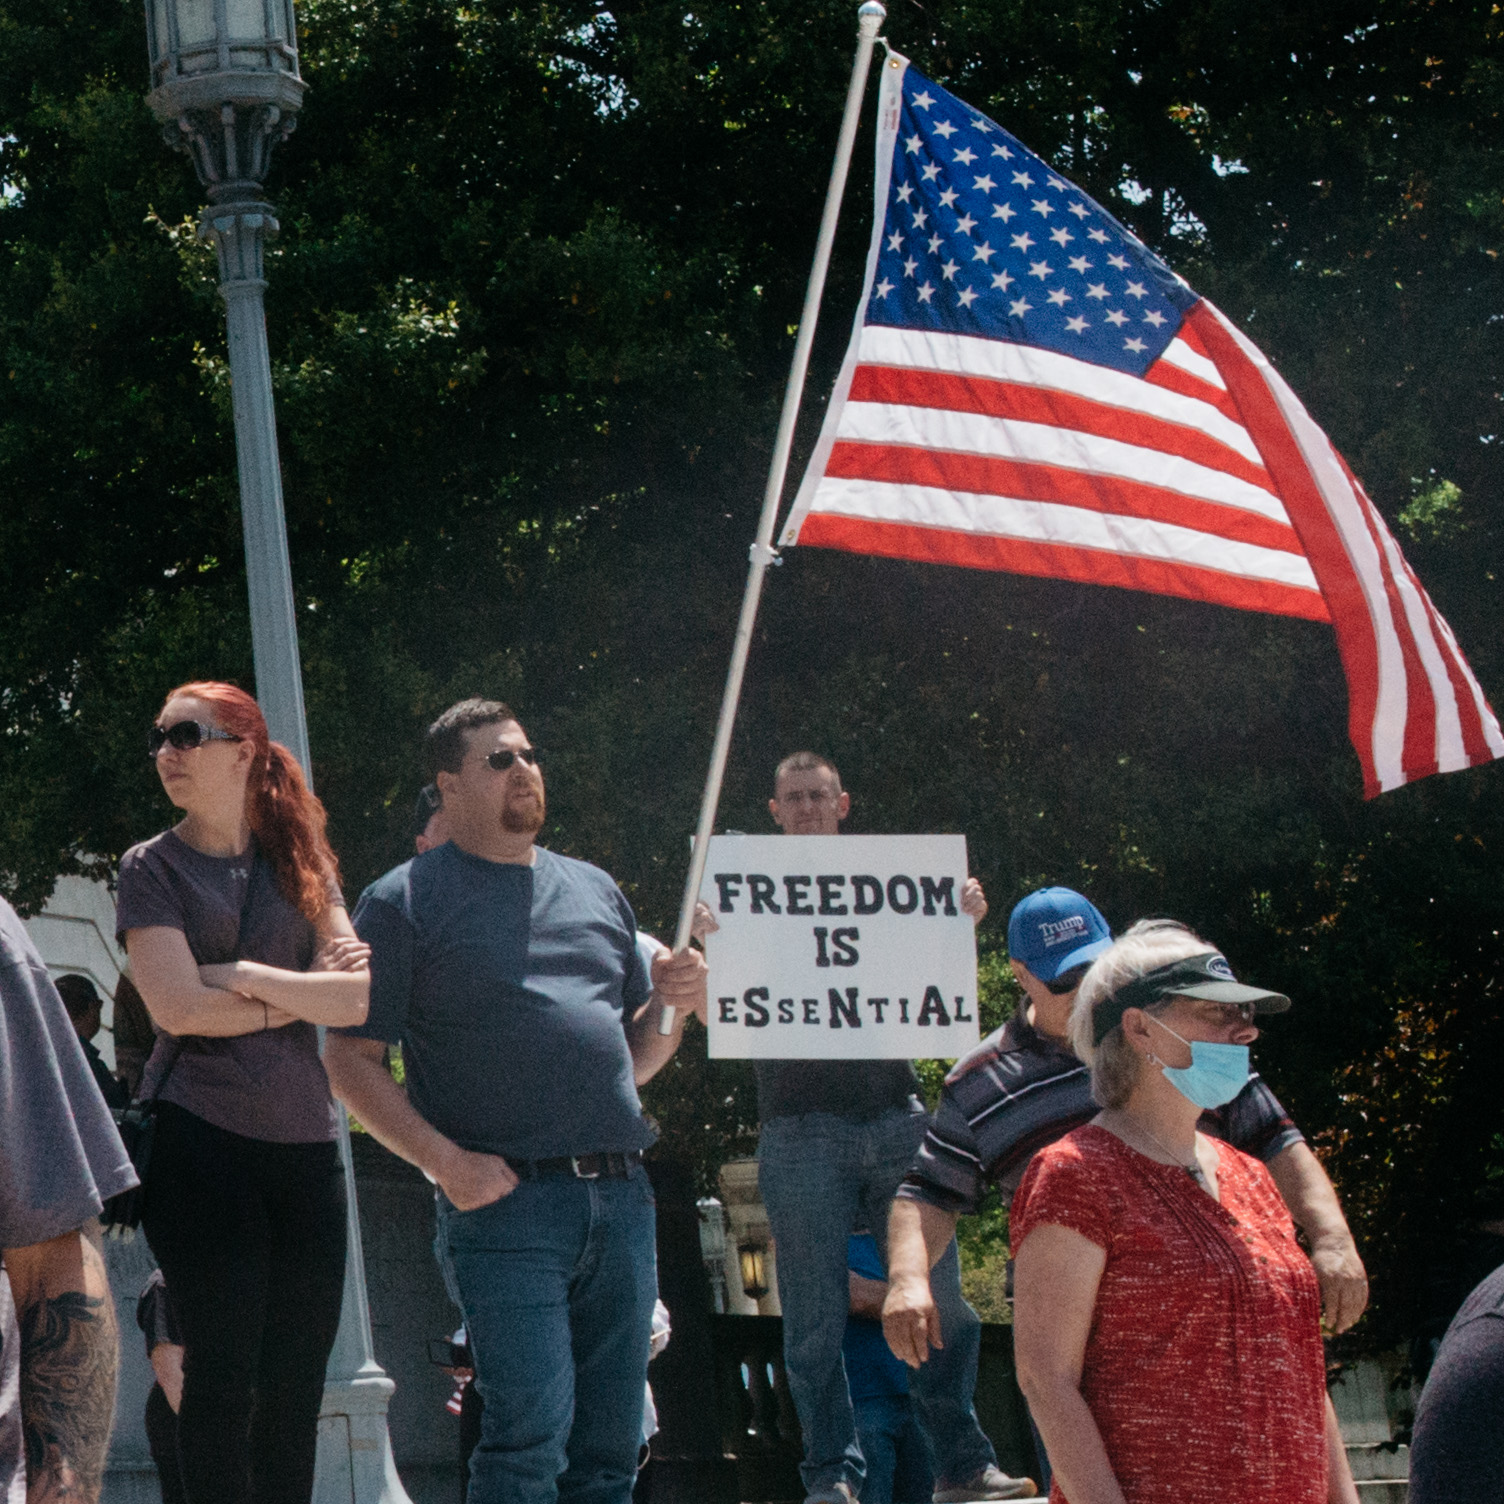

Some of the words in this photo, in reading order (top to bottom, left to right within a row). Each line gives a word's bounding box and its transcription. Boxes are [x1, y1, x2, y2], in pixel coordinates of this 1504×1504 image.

[713, 872, 959, 917] FREEDOM
[812, 926, 861, 968] IS
[1037, 915, 1085, 938] Trump
[717, 984, 973, 1029] ESSENTIAL
